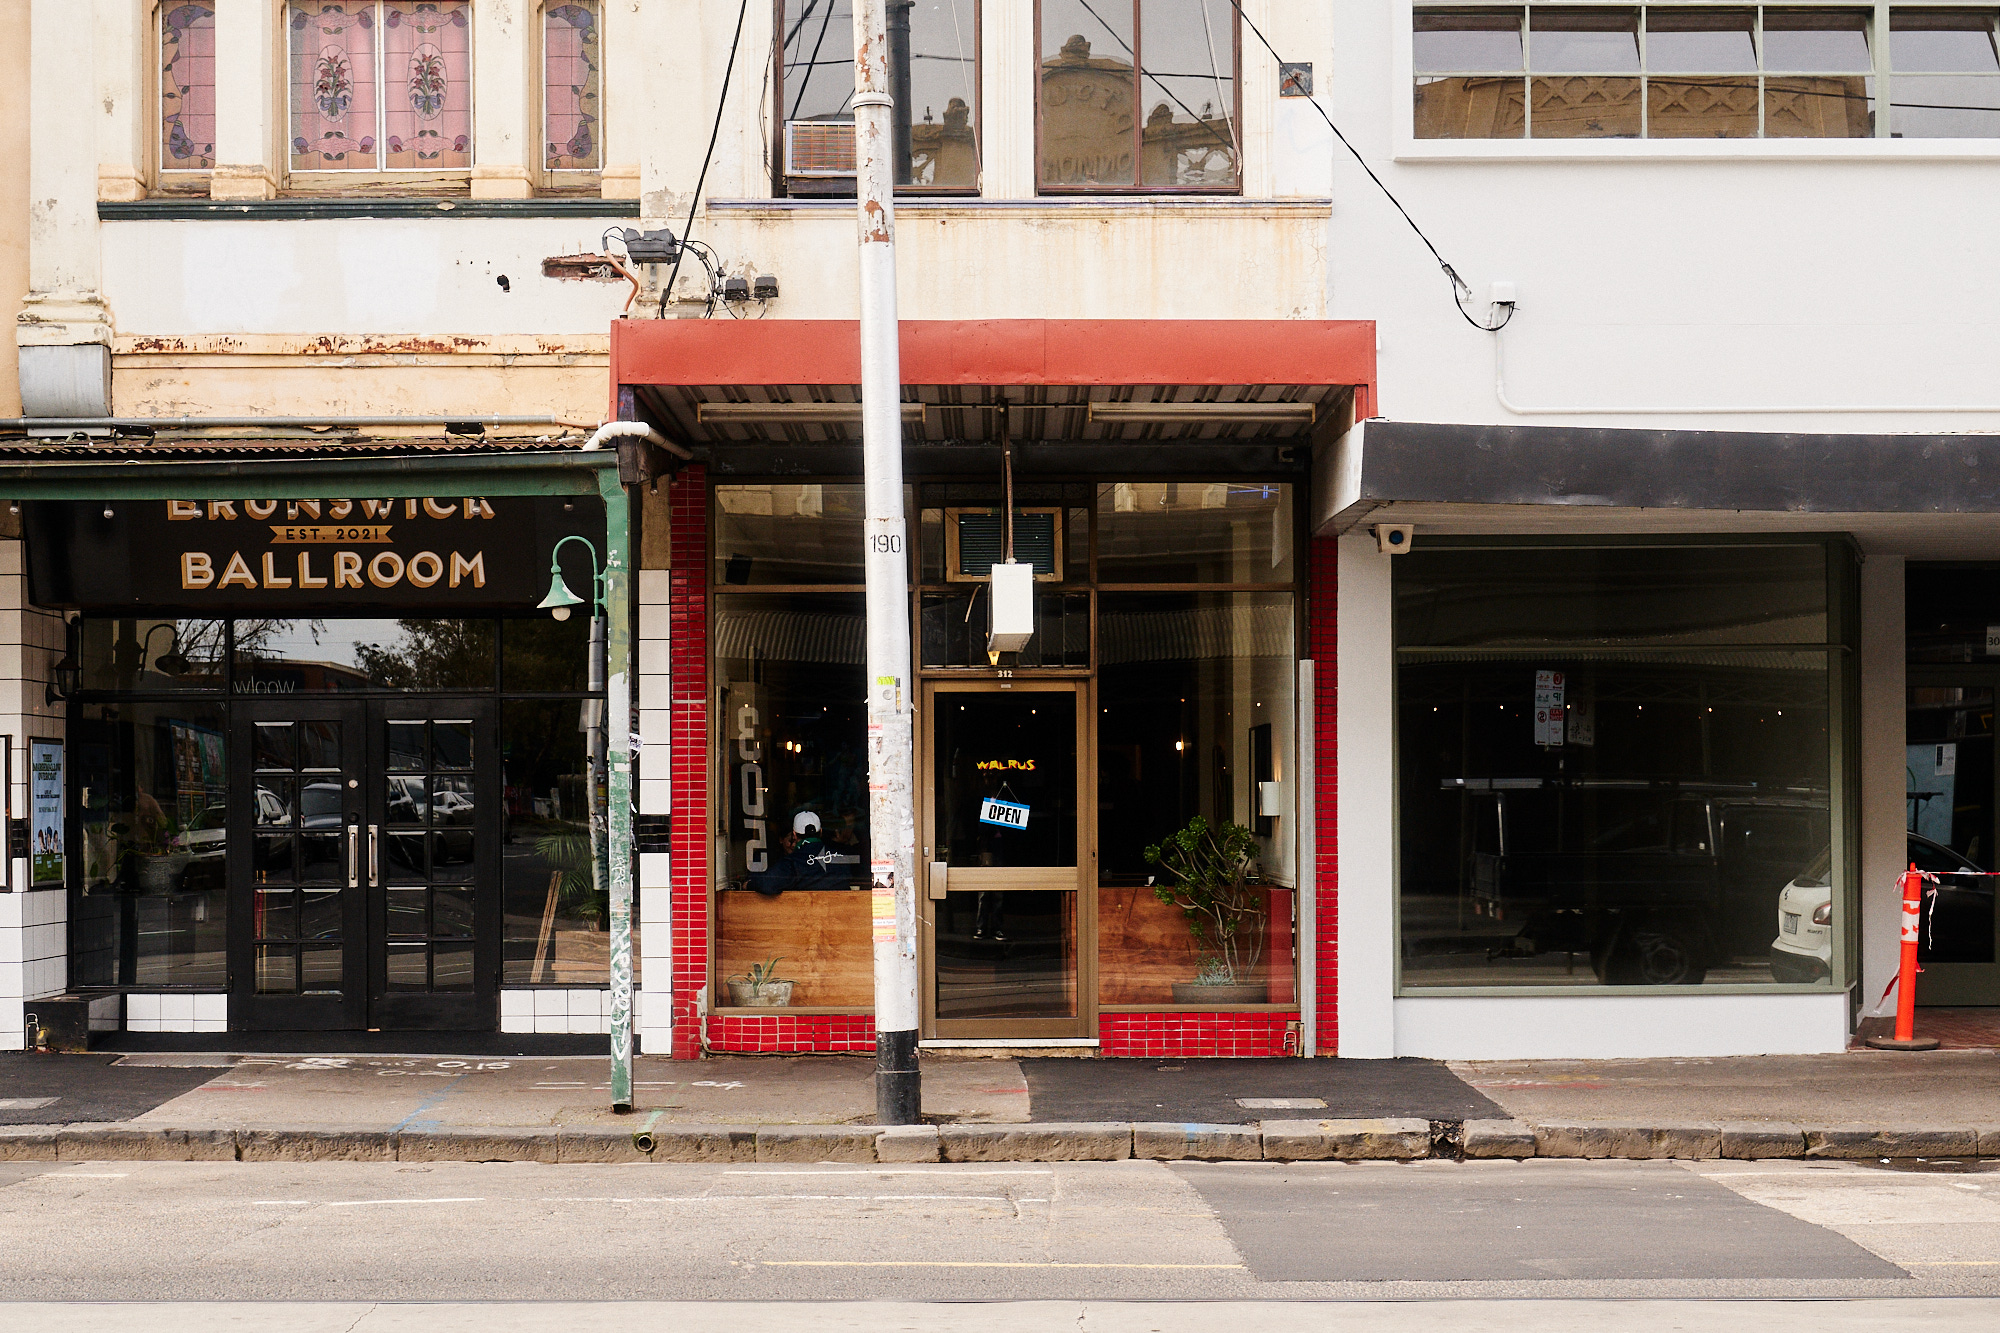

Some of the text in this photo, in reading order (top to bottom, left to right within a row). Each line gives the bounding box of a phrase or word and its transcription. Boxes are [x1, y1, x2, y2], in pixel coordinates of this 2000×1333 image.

[286, 528, 378, 540] EST. 2021
[870, 534, 901, 553] 190
[181, 550, 486, 590] BALLROOM
[997, 670, 1013, 678] 312
[976, 759, 1036, 771] WALRUS
[988, 804, 1022, 825] OPEN
